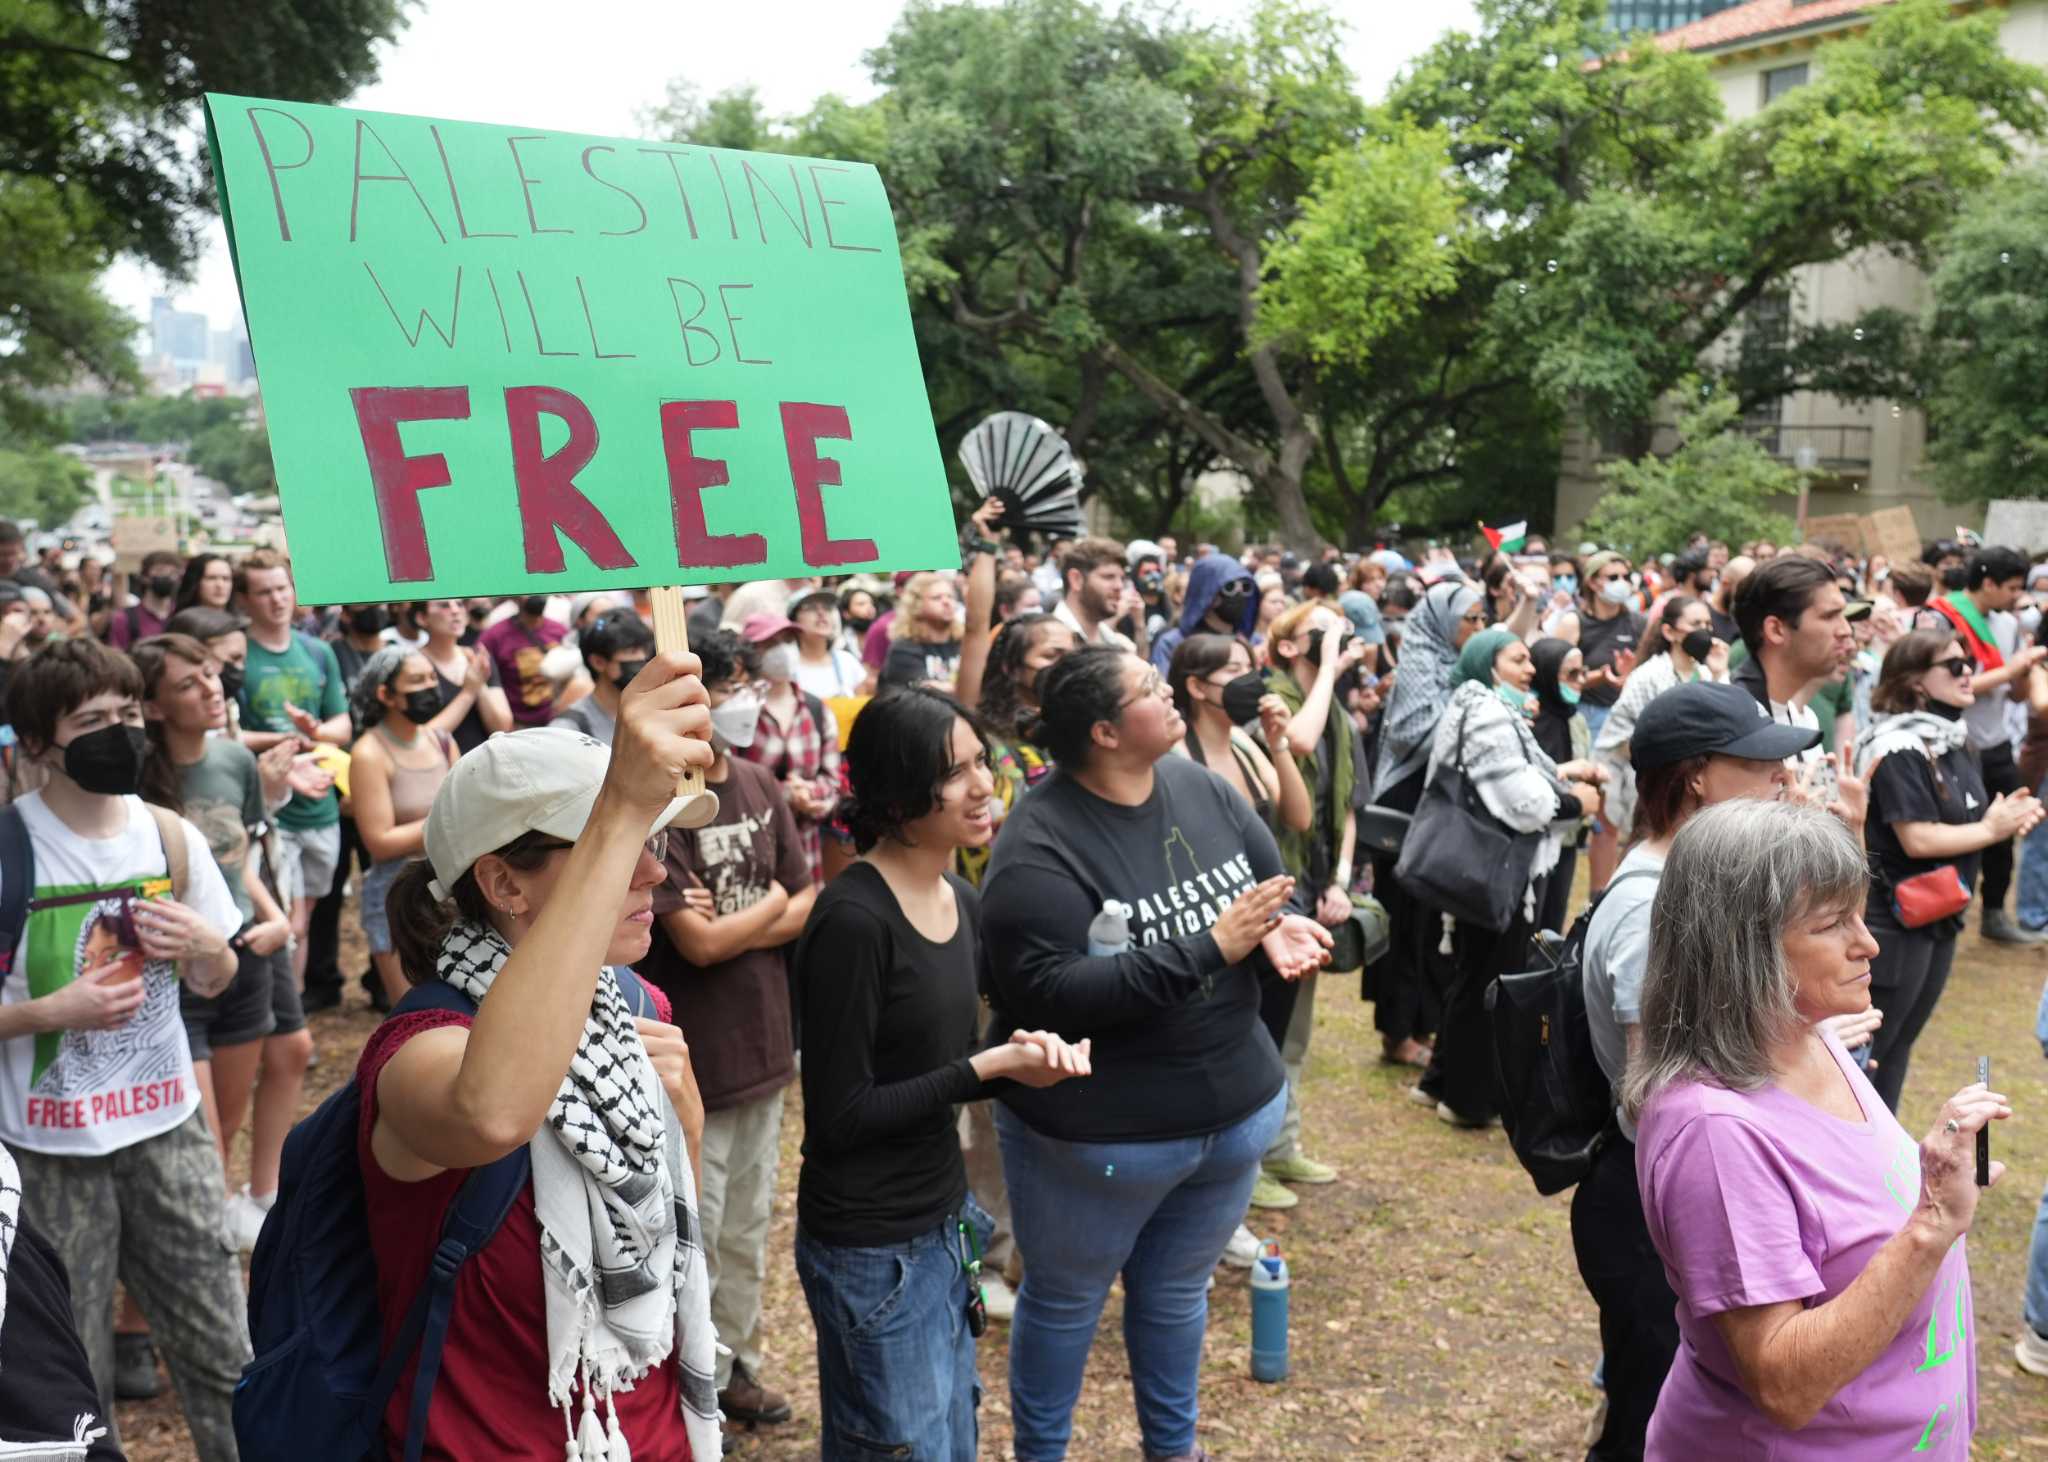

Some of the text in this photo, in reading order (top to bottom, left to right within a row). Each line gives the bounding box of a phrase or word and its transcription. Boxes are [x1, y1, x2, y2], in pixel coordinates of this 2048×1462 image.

[246, 106, 882, 252] PALESTINE
[364, 261, 773, 366] WILL BE
[348, 384, 879, 584] FREE
[1120, 853, 1252, 923] PALESTINE
[28, 1078, 184, 1128] FREE PALESTI
